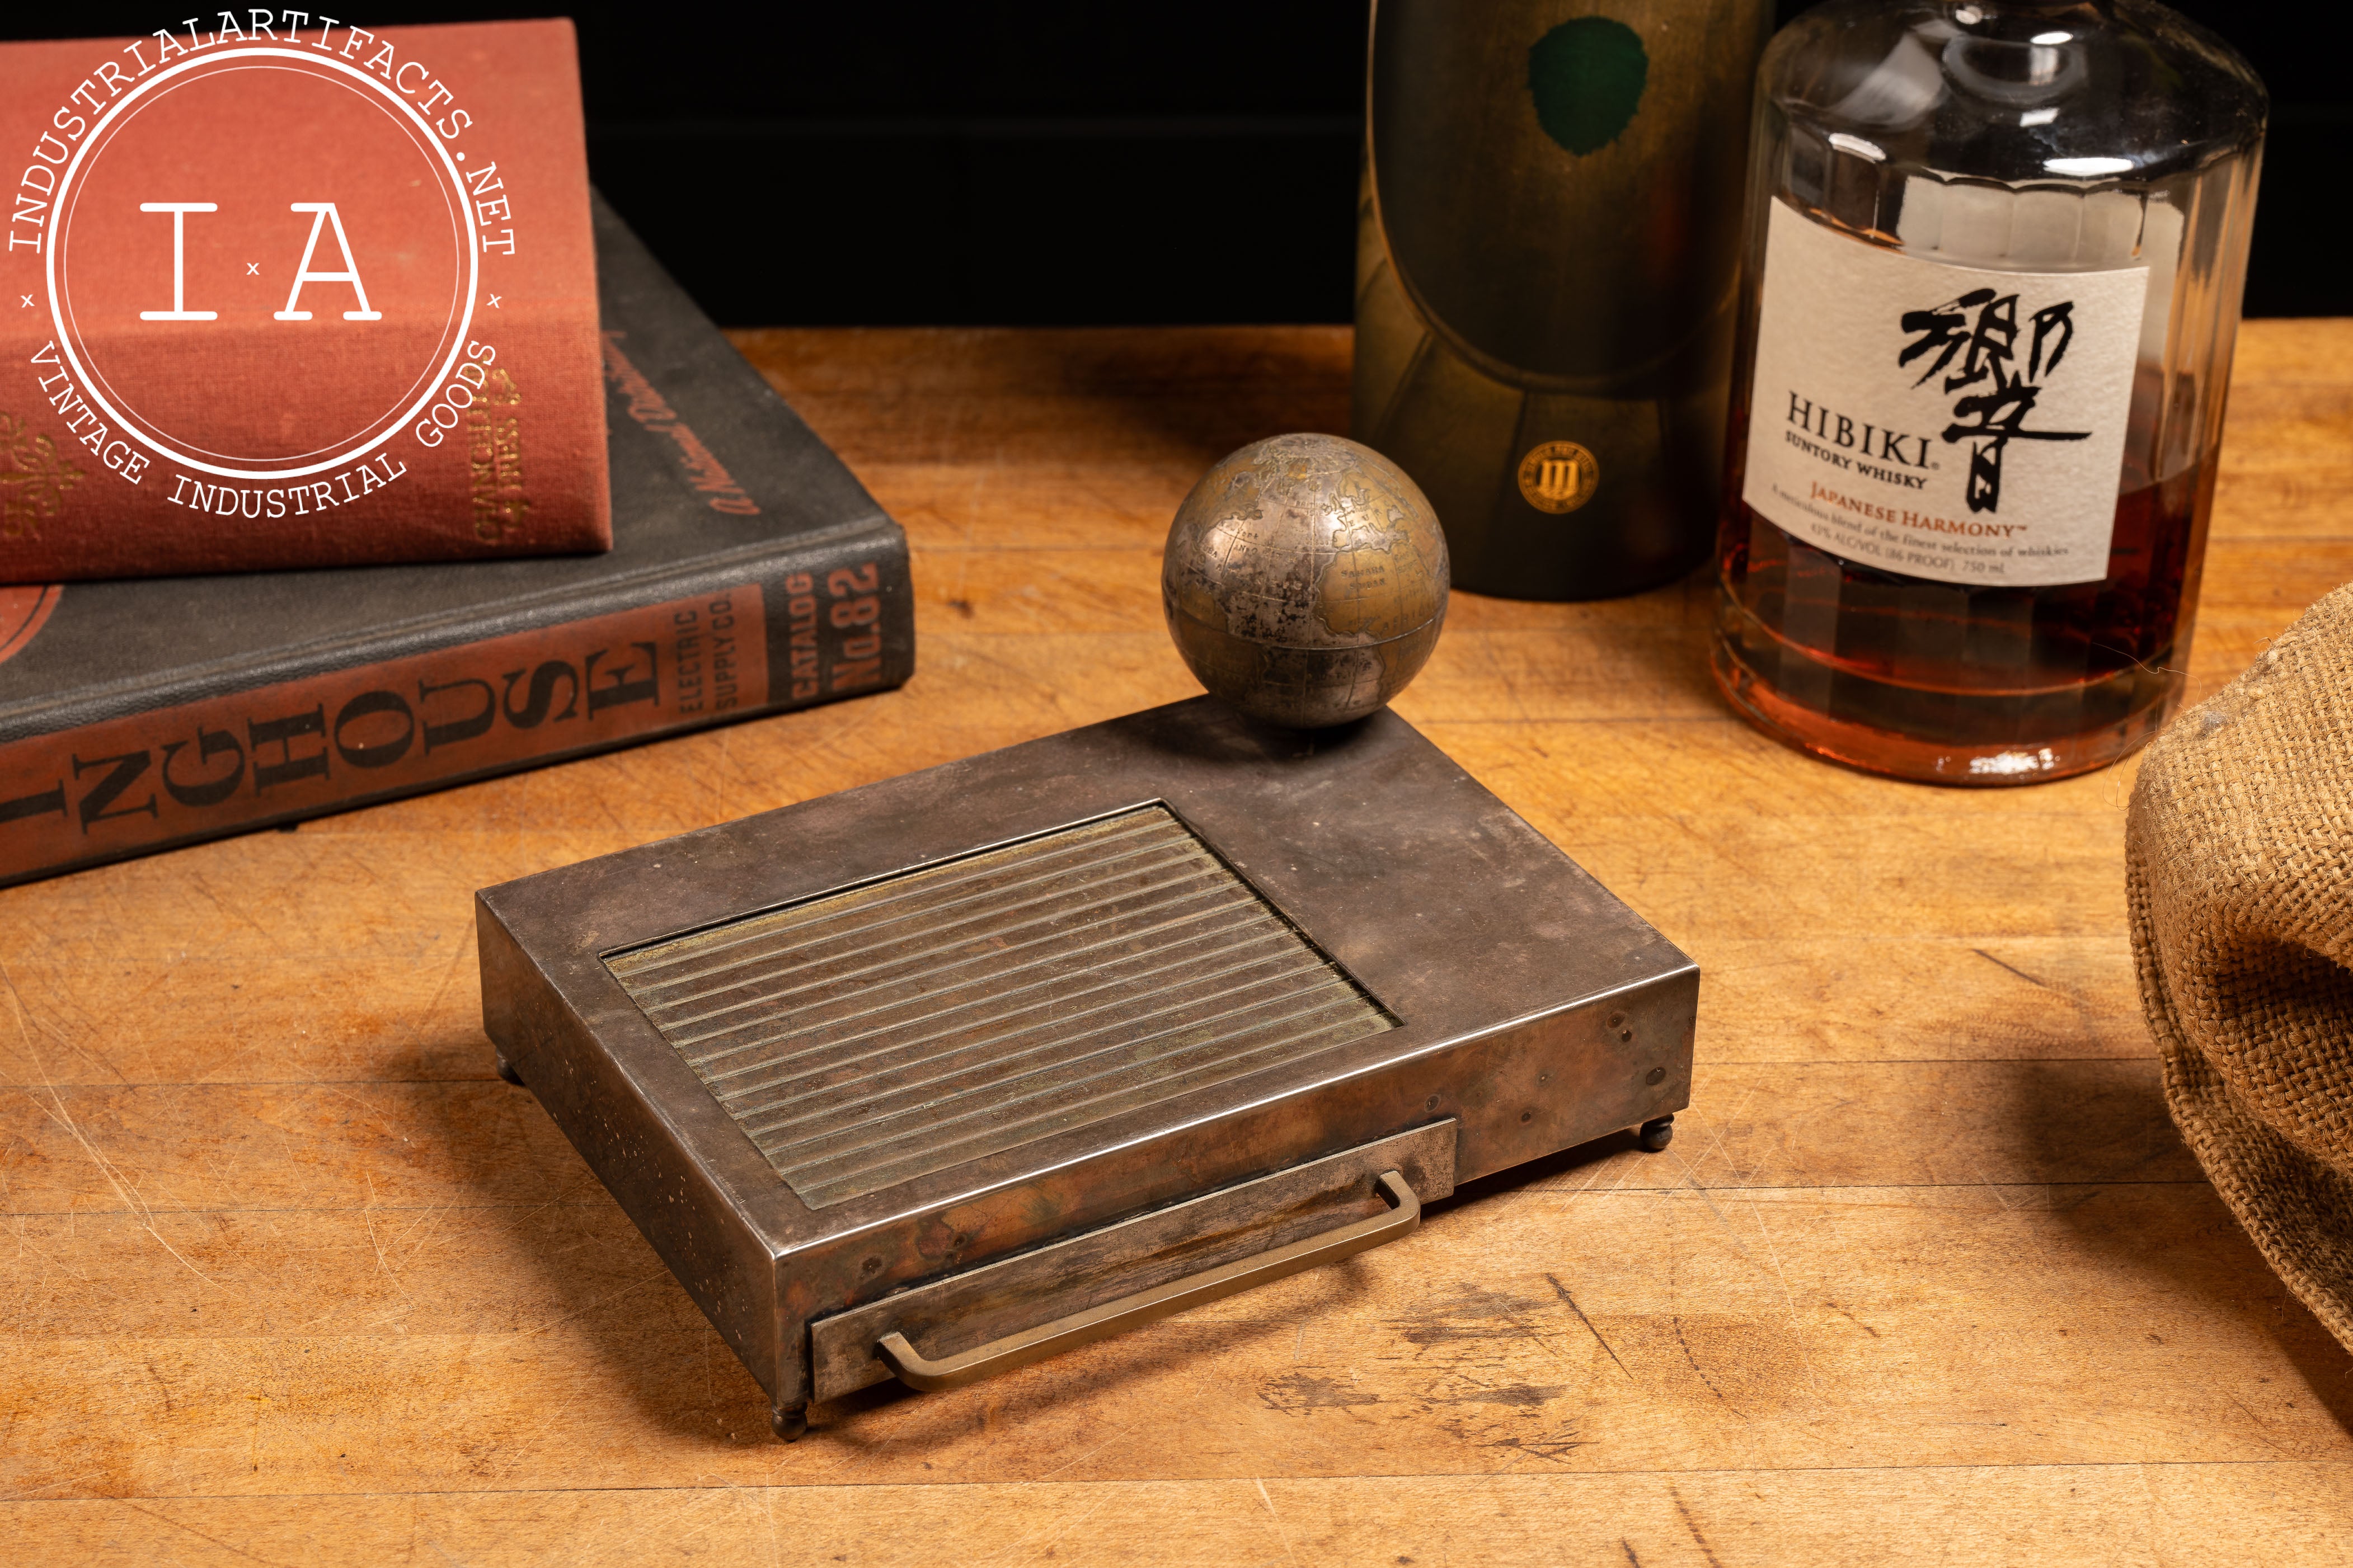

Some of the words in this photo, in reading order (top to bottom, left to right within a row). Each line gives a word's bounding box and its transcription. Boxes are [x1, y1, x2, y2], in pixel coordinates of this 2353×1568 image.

[1785, 430, 1852, 470] SUNTORY
[1856, 461, 1928, 489] WHISKY
[1811, 481, 1896, 524] JAPANESE
[1831, 514, 1862, 533] blend
[1864, 526, 1878, 536] of
[1880, 529, 1899, 543] the
[1903, 533, 1937, 551] finest
[1942, 541, 1996, 556] selection
[2000, 546, 2014, 557] of
[2018, 544, 2069, 557] whiskies
[1962, 560, 1985, 573] 750
[675, 609, 703, 714] ELECTRIC
[785, 572, 819, 700] CATALOG
[713, 637, 738, 711] SUPPLY
[0, 641, 659, 835] INGHOUSE
